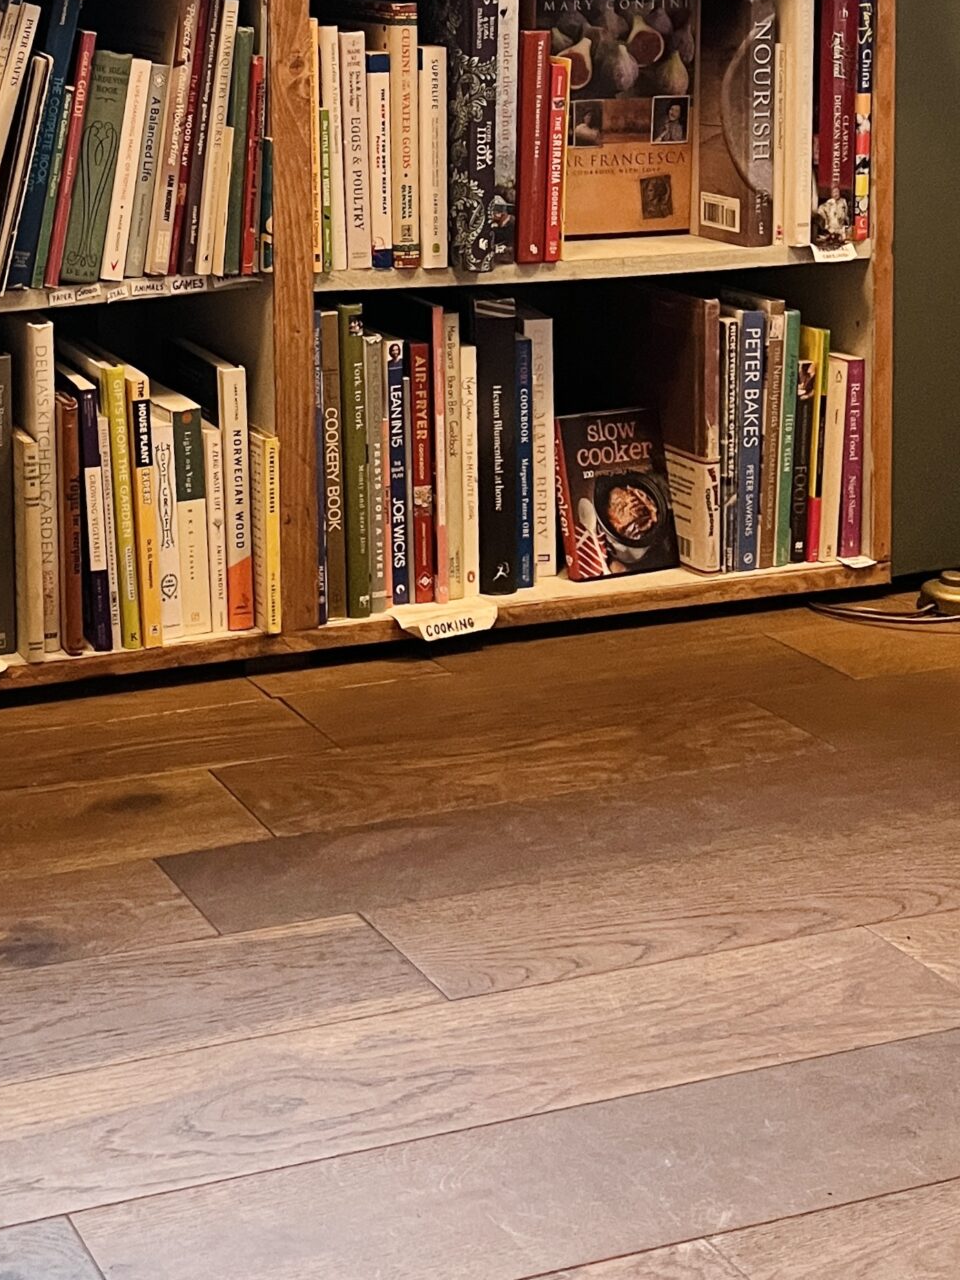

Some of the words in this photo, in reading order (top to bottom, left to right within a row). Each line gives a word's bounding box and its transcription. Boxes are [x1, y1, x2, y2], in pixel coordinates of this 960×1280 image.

[544, 0, 593, 11] MARY
[18, 18, 34, 48] PAPER
[10, 51, 27, 86] CRAFTS
[401, 28, 411, 76] CUISINE
[861, 49, 872, 88] China
[152, 97, 161, 105] A
[431, 59, 439, 109] SUPERLIFE
[753, 21, 772, 162] NOURISH
[401, 93, 412, 133] WATER
[833, 94, 841, 139] DICKSON
[144, 107, 160, 158] Balanced
[350, 117, 362, 152] EGGS
[352, 157, 362, 165] &
[401, 137, 412, 169] GODS
[551, 133, 562, 184] SRIRACHA
[591, 152, 687, 167] FRANCESCA
[141, 161, 155, 182] Life
[352, 170, 364, 231] POULTRY
[550, 186, 559, 227] COOKBOOK
[134, 284, 164, 292] ANIMALS
[173, 279, 204, 290] GAMES
[745, 328, 760, 382] PETER
[34, 346, 48, 407] DELIA'S
[137, 380, 146, 398] The
[850, 383, 860, 405] Real
[113, 380, 124, 415] GIFTS
[390, 384, 402, 418] LEAN
[493, 385, 503, 418] Heston
[139, 403, 147, 433] HOUSE
[391, 420, 402, 434] IN
[520, 388, 528, 443] COOKBOOK
[587, 419, 637, 442] slow
[743, 389, 759, 448] BAKES
[849, 409, 860, 430] Fast
[37, 411, 49, 495] KITCHEN
[115, 418, 126, 454] FROM
[140, 436, 149, 463] PLANT
[183, 431, 192, 455] Light
[325, 407, 340, 481] COOKERY
[391, 435, 403, 447] 15
[493, 420, 504, 474] Blumenthal
[577, 440, 653, 467] cooker
[849, 434, 859, 461] Food
[118, 458, 128, 482] THE
[185, 459, 192, 469] on
[233, 430, 243, 506] NORWEGIAN
[373, 443, 382, 490] FEASTS
[494, 475, 503, 484] at
[745, 464, 754, 491] PETER
[142, 468, 152, 505] EXPERT
[184, 471, 193, 493] Yoga
[494, 484, 504, 511] home
[793, 465, 807, 514] FOOD
[120, 485, 131, 538] GARDEN
[327, 486, 341, 532] BOOK
[375, 497, 383, 521] FOR
[392, 497, 404, 527] JOE
[744, 493, 753, 536] SAWKINS
[38, 499, 53, 564] GARDEN
[234, 511, 246, 549] WOOD
[376, 541, 384, 578] FIVER
[393, 528, 405, 568] WICKS
[426, 618, 474, 637] COOKING
